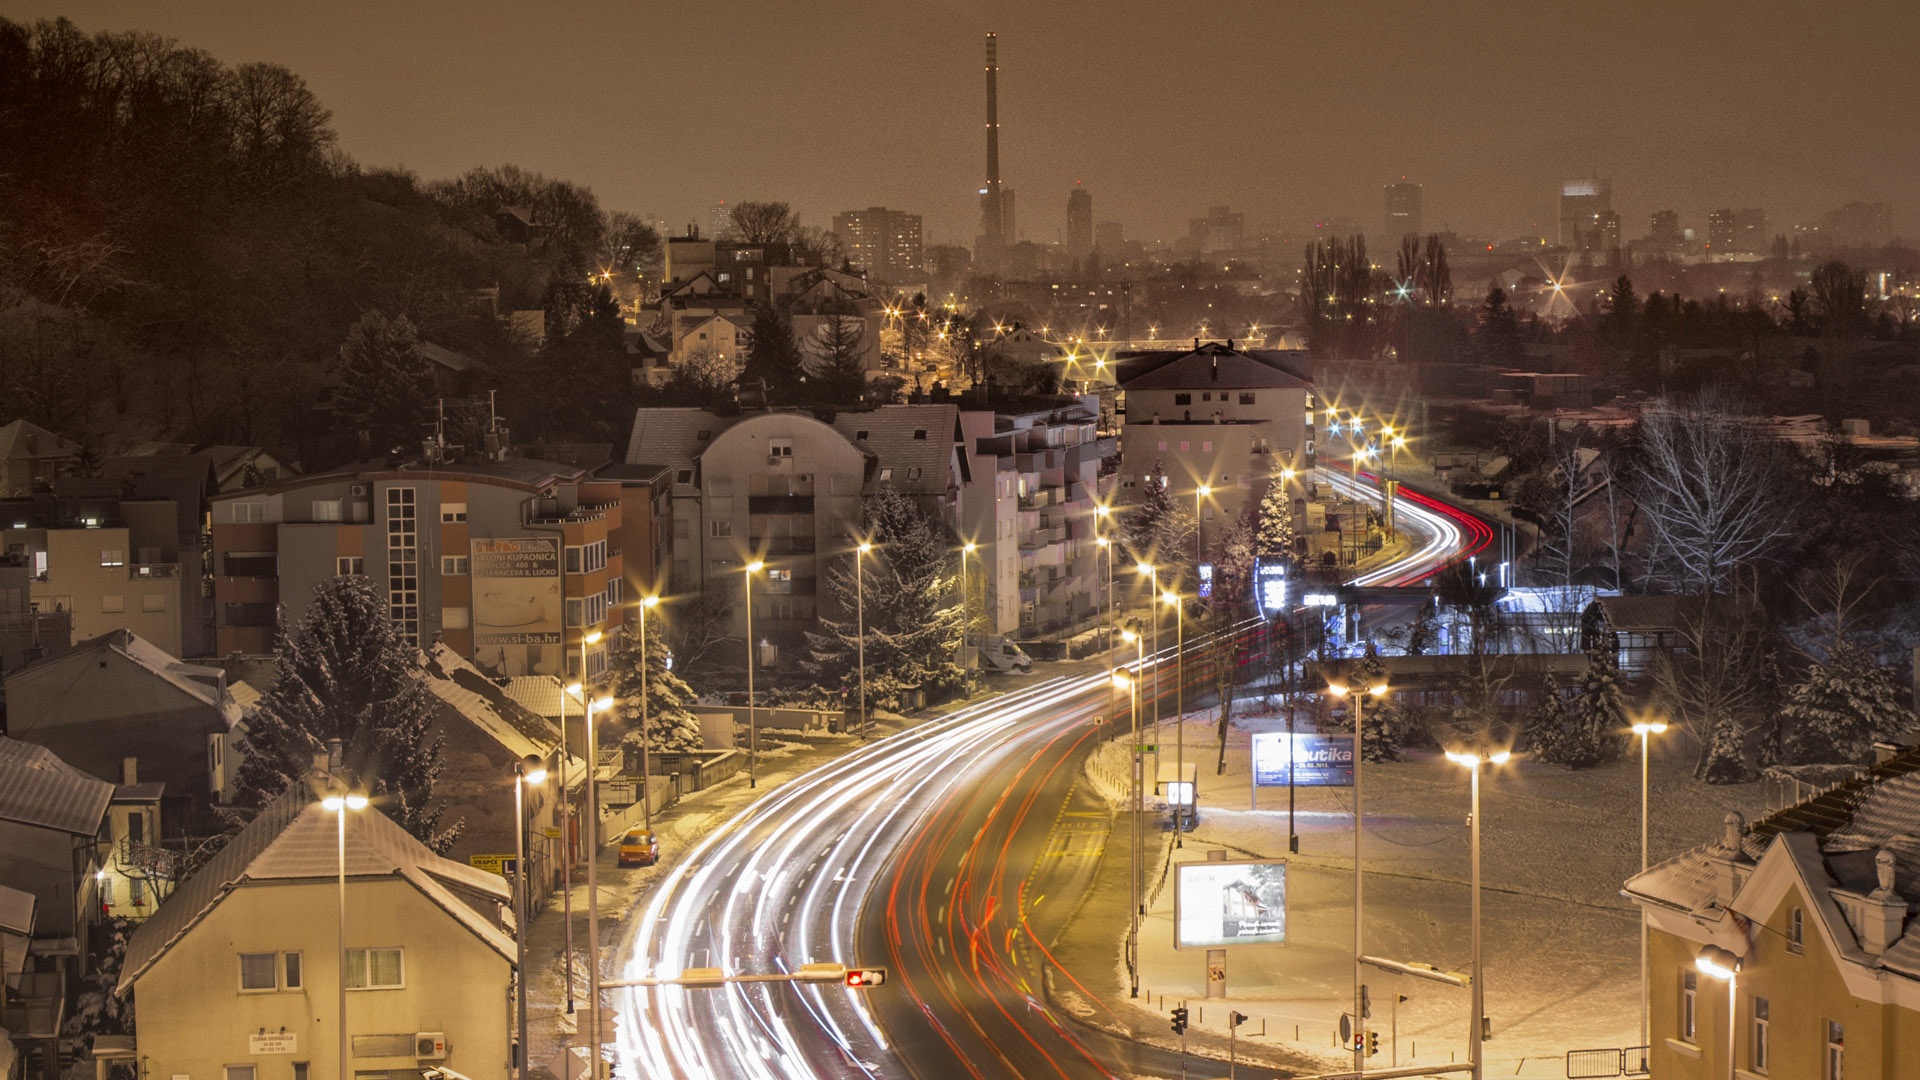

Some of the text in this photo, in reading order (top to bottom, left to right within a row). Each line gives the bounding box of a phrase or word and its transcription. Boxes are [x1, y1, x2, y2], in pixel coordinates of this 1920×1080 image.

[507, 553, 556, 561] KUPAONICA
[532, 568, 557, 576] LUČKO
[477, 634, 559, 644] www.si-ba.hr
